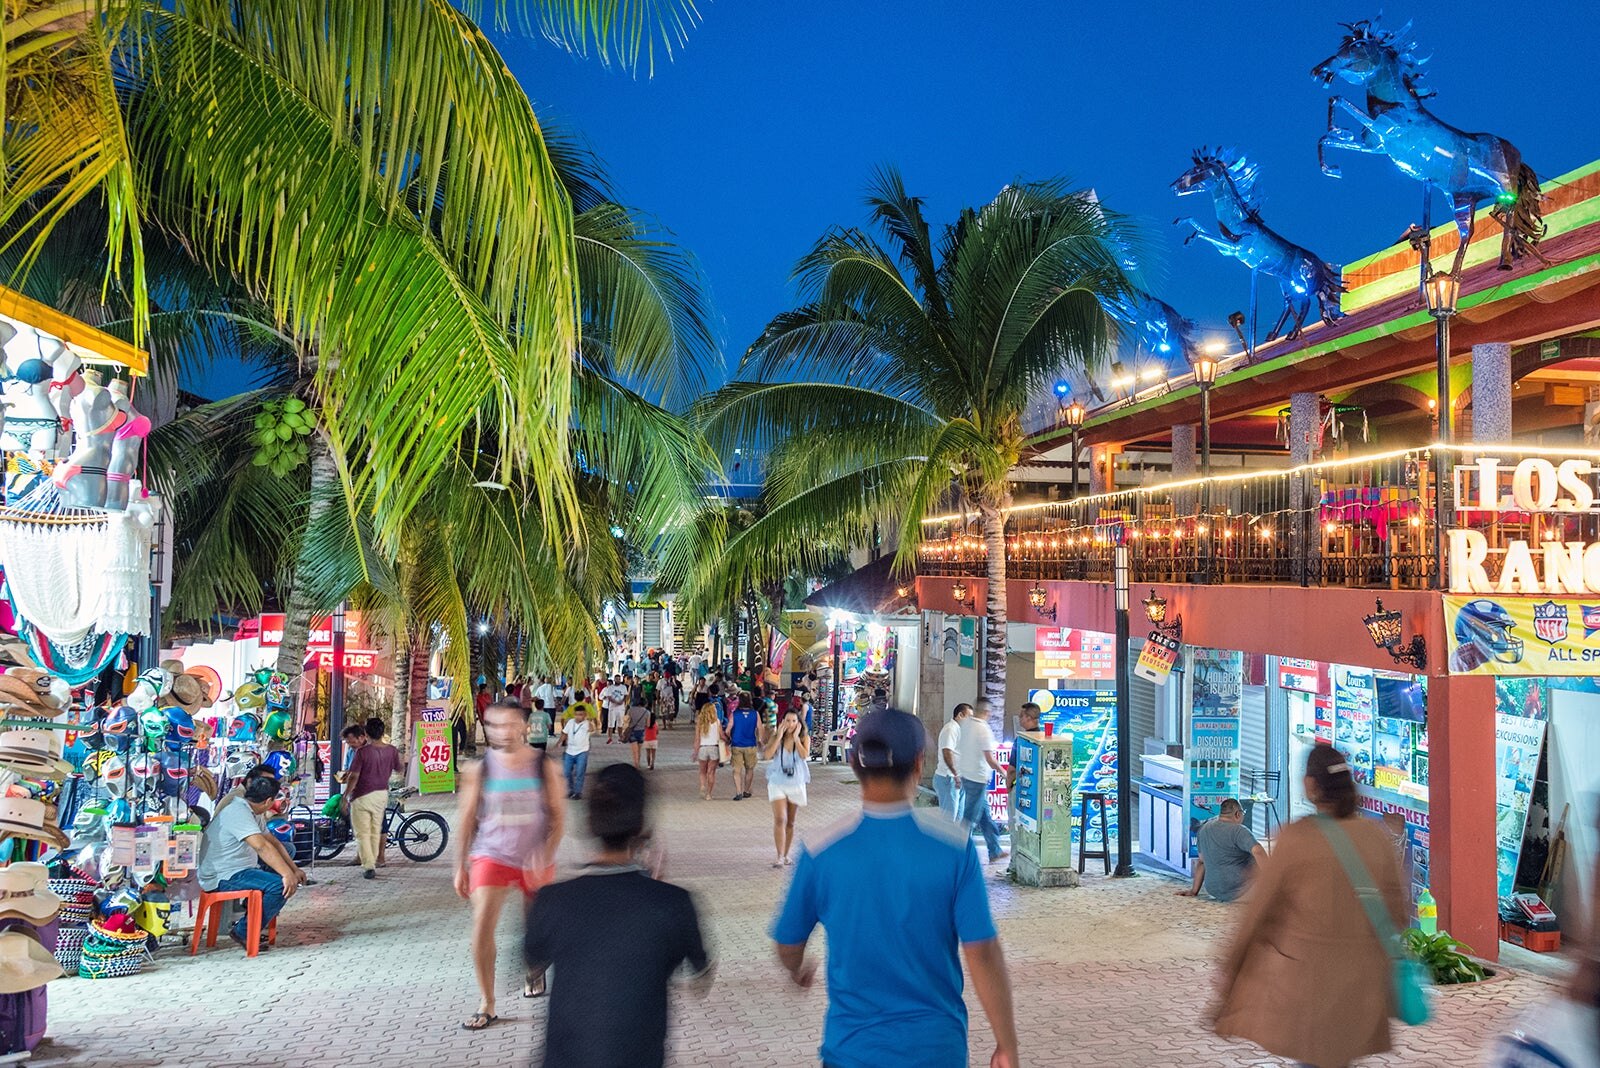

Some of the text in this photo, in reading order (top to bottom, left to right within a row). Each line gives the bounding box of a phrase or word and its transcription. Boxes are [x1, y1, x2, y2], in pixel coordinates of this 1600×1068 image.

[1475, 457, 1594, 513] LOS
[1536, 619, 1565, 640] NFL
[1151, 632, 1176, 649] INFO
[1150, 646, 1169, 657] AUF
[1548, 647, 1577, 662] ALL
[1347, 677, 1366, 688] tours
[1055, 695, 1089, 707] tours
[1197, 736, 1233, 748] DISCOVER
[1496, 730, 1539, 746] EXCURSIONS
[420, 745, 451, 763] $45
[425, 764, 448, 773] PESOS
[1196, 759, 1233, 778] LIFE
